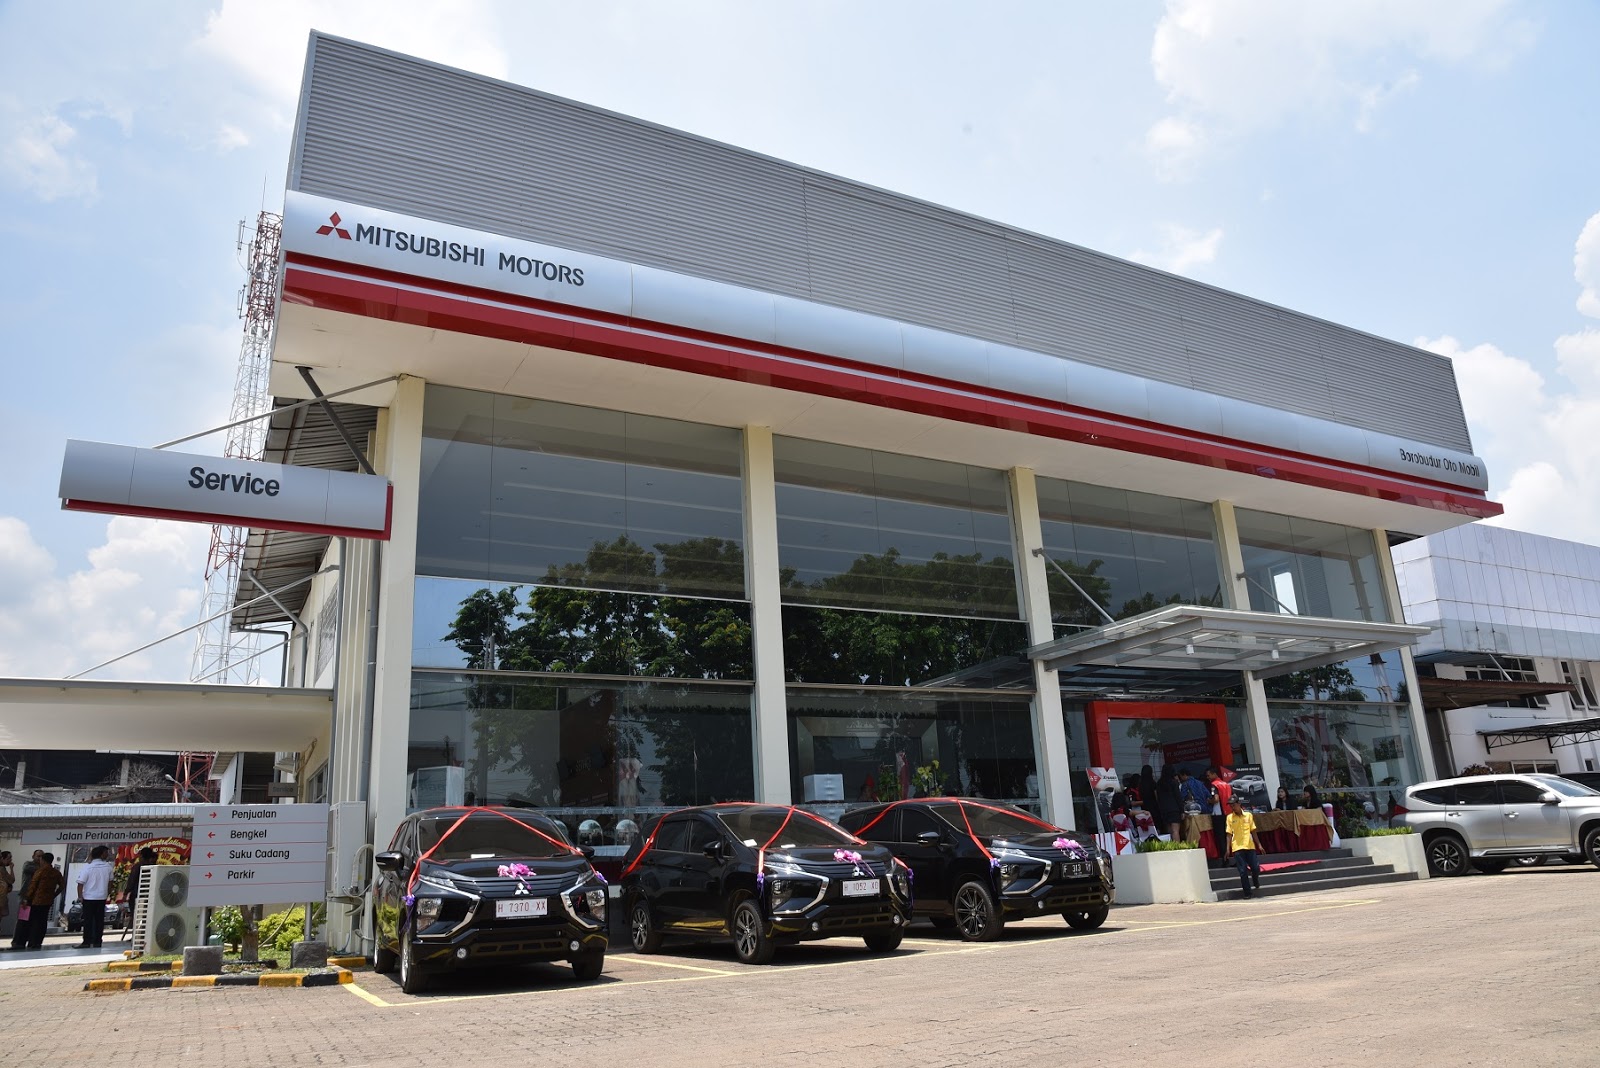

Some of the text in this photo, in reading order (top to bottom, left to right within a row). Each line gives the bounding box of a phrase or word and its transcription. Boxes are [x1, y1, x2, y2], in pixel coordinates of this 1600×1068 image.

[355, 222, 585, 287] MITSUBISHI MOTORS
[1399, 448, 1480, 478] Borobudur Oto Mobil
[188, 466, 280, 497] Service
[231, 809, 277, 820] Penjualan
[56, 831, 154, 841] Jalan Perlahan-lahan
[230, 829, 267, 840] Bengkel
[229, 849, 290, 860] Suku Cadang
[227, 869, 255, 880] Parkir
[853, 882, 867, 892] 1052
[497, 900, 546, 913] H 7370 XX
